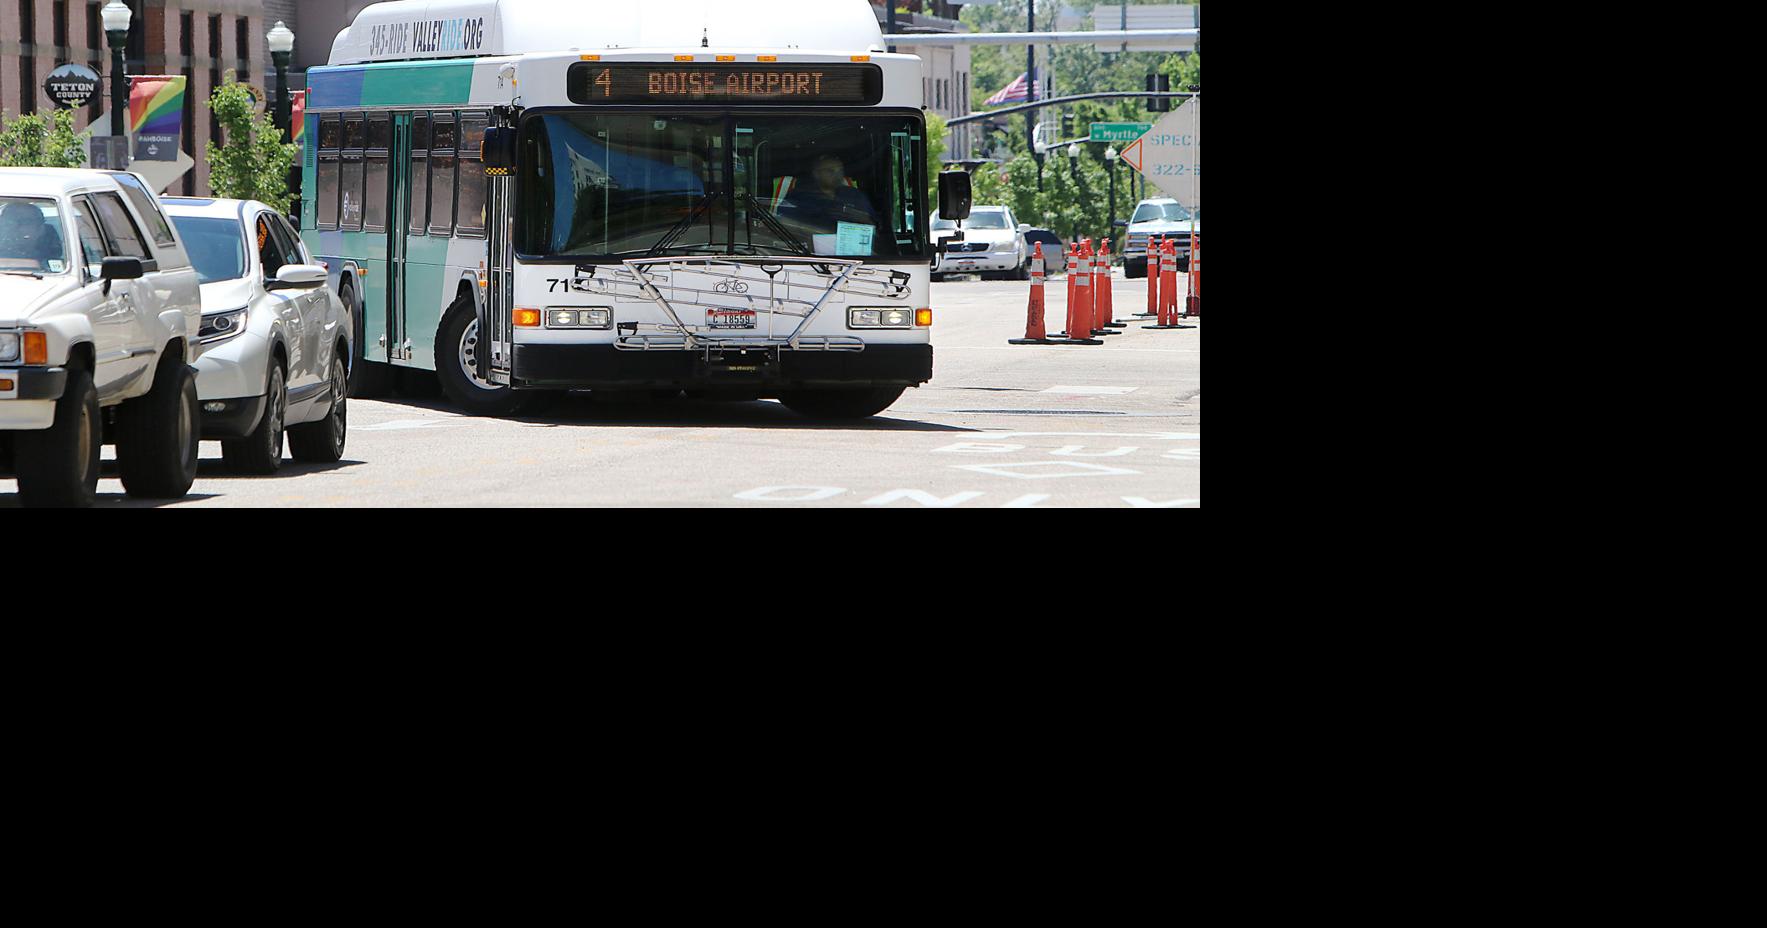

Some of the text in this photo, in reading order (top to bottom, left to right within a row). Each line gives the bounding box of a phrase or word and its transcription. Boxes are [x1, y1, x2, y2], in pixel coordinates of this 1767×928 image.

[369, 22, 408, 56] 345-RIDE
[50, 82, 94, 92] TETON
[595, 69, 823, 97] 4 BOISE AIRPORT
[1103, 130, 1139, 141] Myrtle
[1151, 135, 1200, 146] SPEC
[712, 314, 751, 324] C 18559
